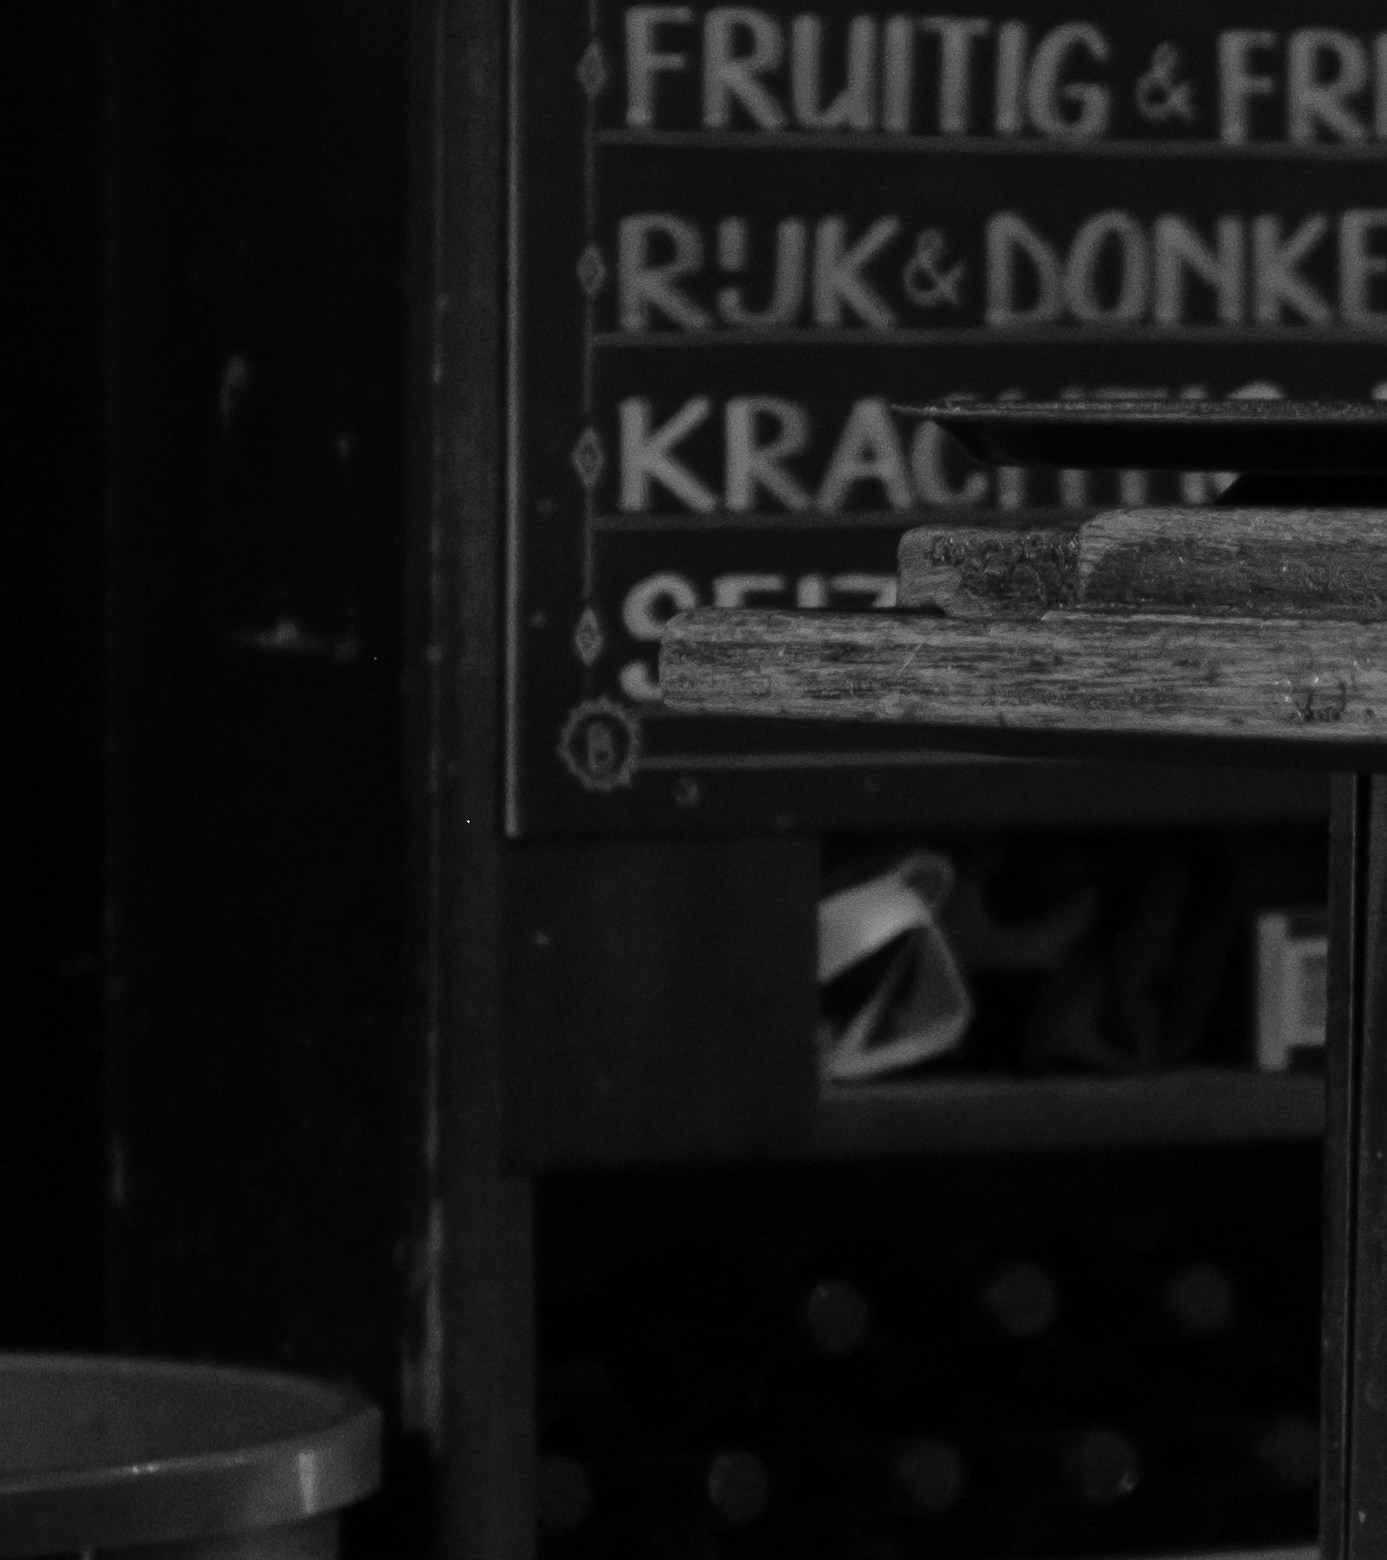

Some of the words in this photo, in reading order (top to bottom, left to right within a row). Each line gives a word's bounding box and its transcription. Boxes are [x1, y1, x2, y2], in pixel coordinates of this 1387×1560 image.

[623, 5, 1116, 139] FRUITIG
[1134, 41, 1197, 123] &
[902, 226, 968, 309] &
